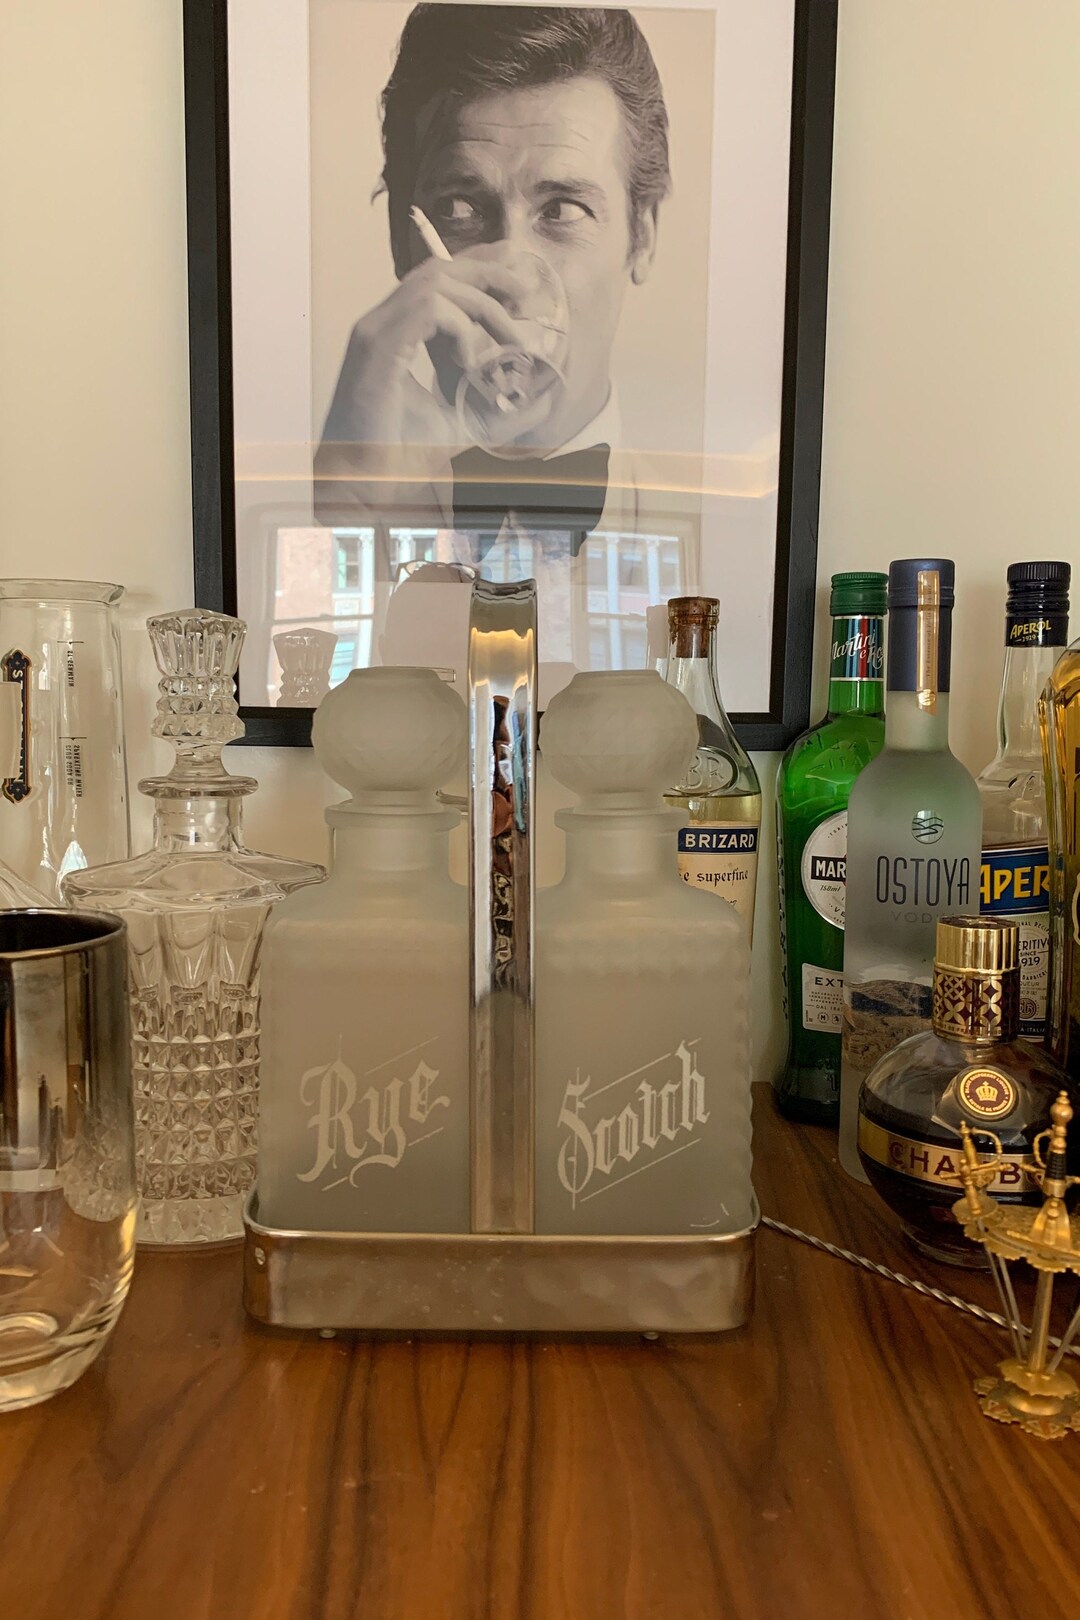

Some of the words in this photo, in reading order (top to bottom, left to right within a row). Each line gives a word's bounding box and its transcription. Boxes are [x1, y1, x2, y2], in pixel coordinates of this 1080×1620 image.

[1009, 619, 1052, 639] APEROL
[1022, 634, 1036, 642] 1919
[685, 833, 755, 849] BRIZARD
[697, 867, 749, 887] superfine
[876, 855, 970, 907] OSTOYA
[980, 863, 1049, 905] APER
[295, 1038, 450, 1189] Rye
[556, 1038, 711, 1211] Scotch
